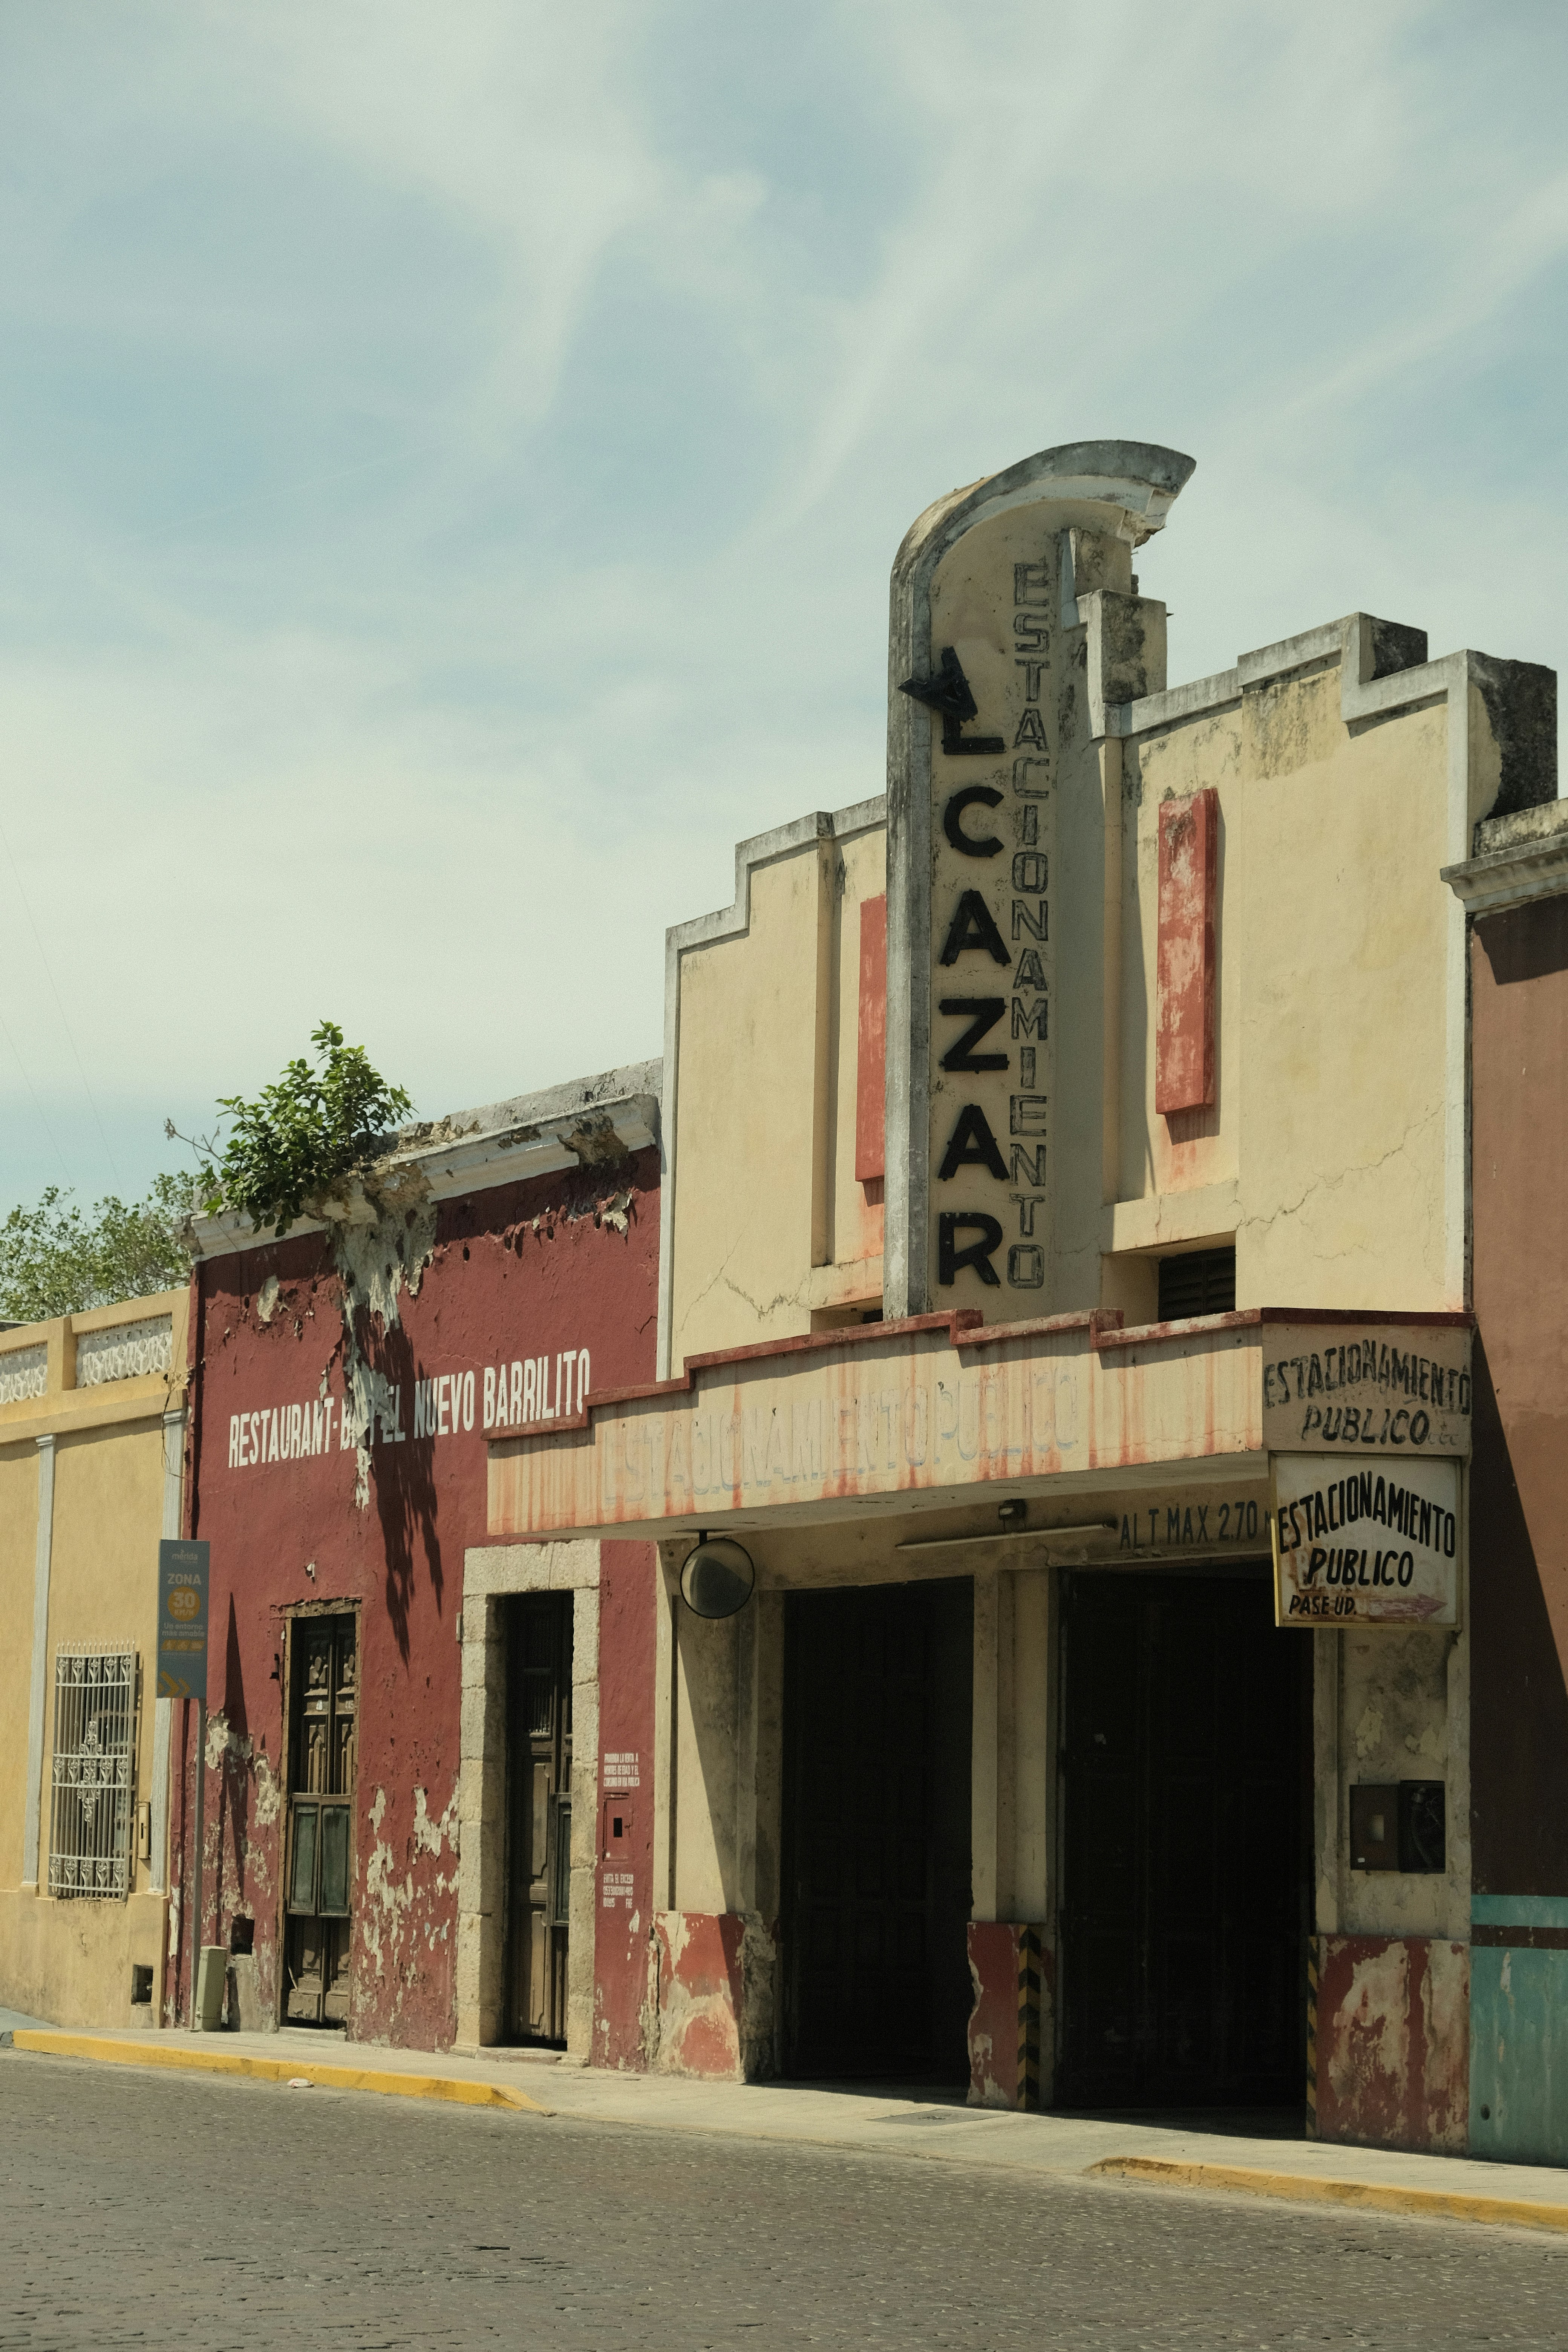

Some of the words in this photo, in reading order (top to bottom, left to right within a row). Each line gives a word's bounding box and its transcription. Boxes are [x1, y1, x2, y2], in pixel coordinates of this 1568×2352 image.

[1007, 562, 1049, 1289] ESTACIONAMIENTO
[898, 646, 1012, 1286] ALCAZAR
[414, 1370, 475, 1439] NUEVO
[483, 1348, 591, 1429] BARRILITO
[1263, 1340, 1471, 1415] ESTACIONAMIENTO
[1302, 1405, 1430, 1446] PUBLICO
[1219, 1500, 1258, 1541] 2.70
[1278, 1471, 1455, 1558] ESTACIONAMIENTO
[167, 1574, 201, 1585] ZONA
[1308, 1548, 1414, 1588] PUBLICO
[173, 1592, 195, 1608] 30
[1289, 1595, 1330, 1615] PASE
[1334, 1596, 1357, 1615] UD.
[631, 1765, 634, 1775] Y
[635, 1753, 639, 1763] A
[615, 1874, 619, 1884] EL
